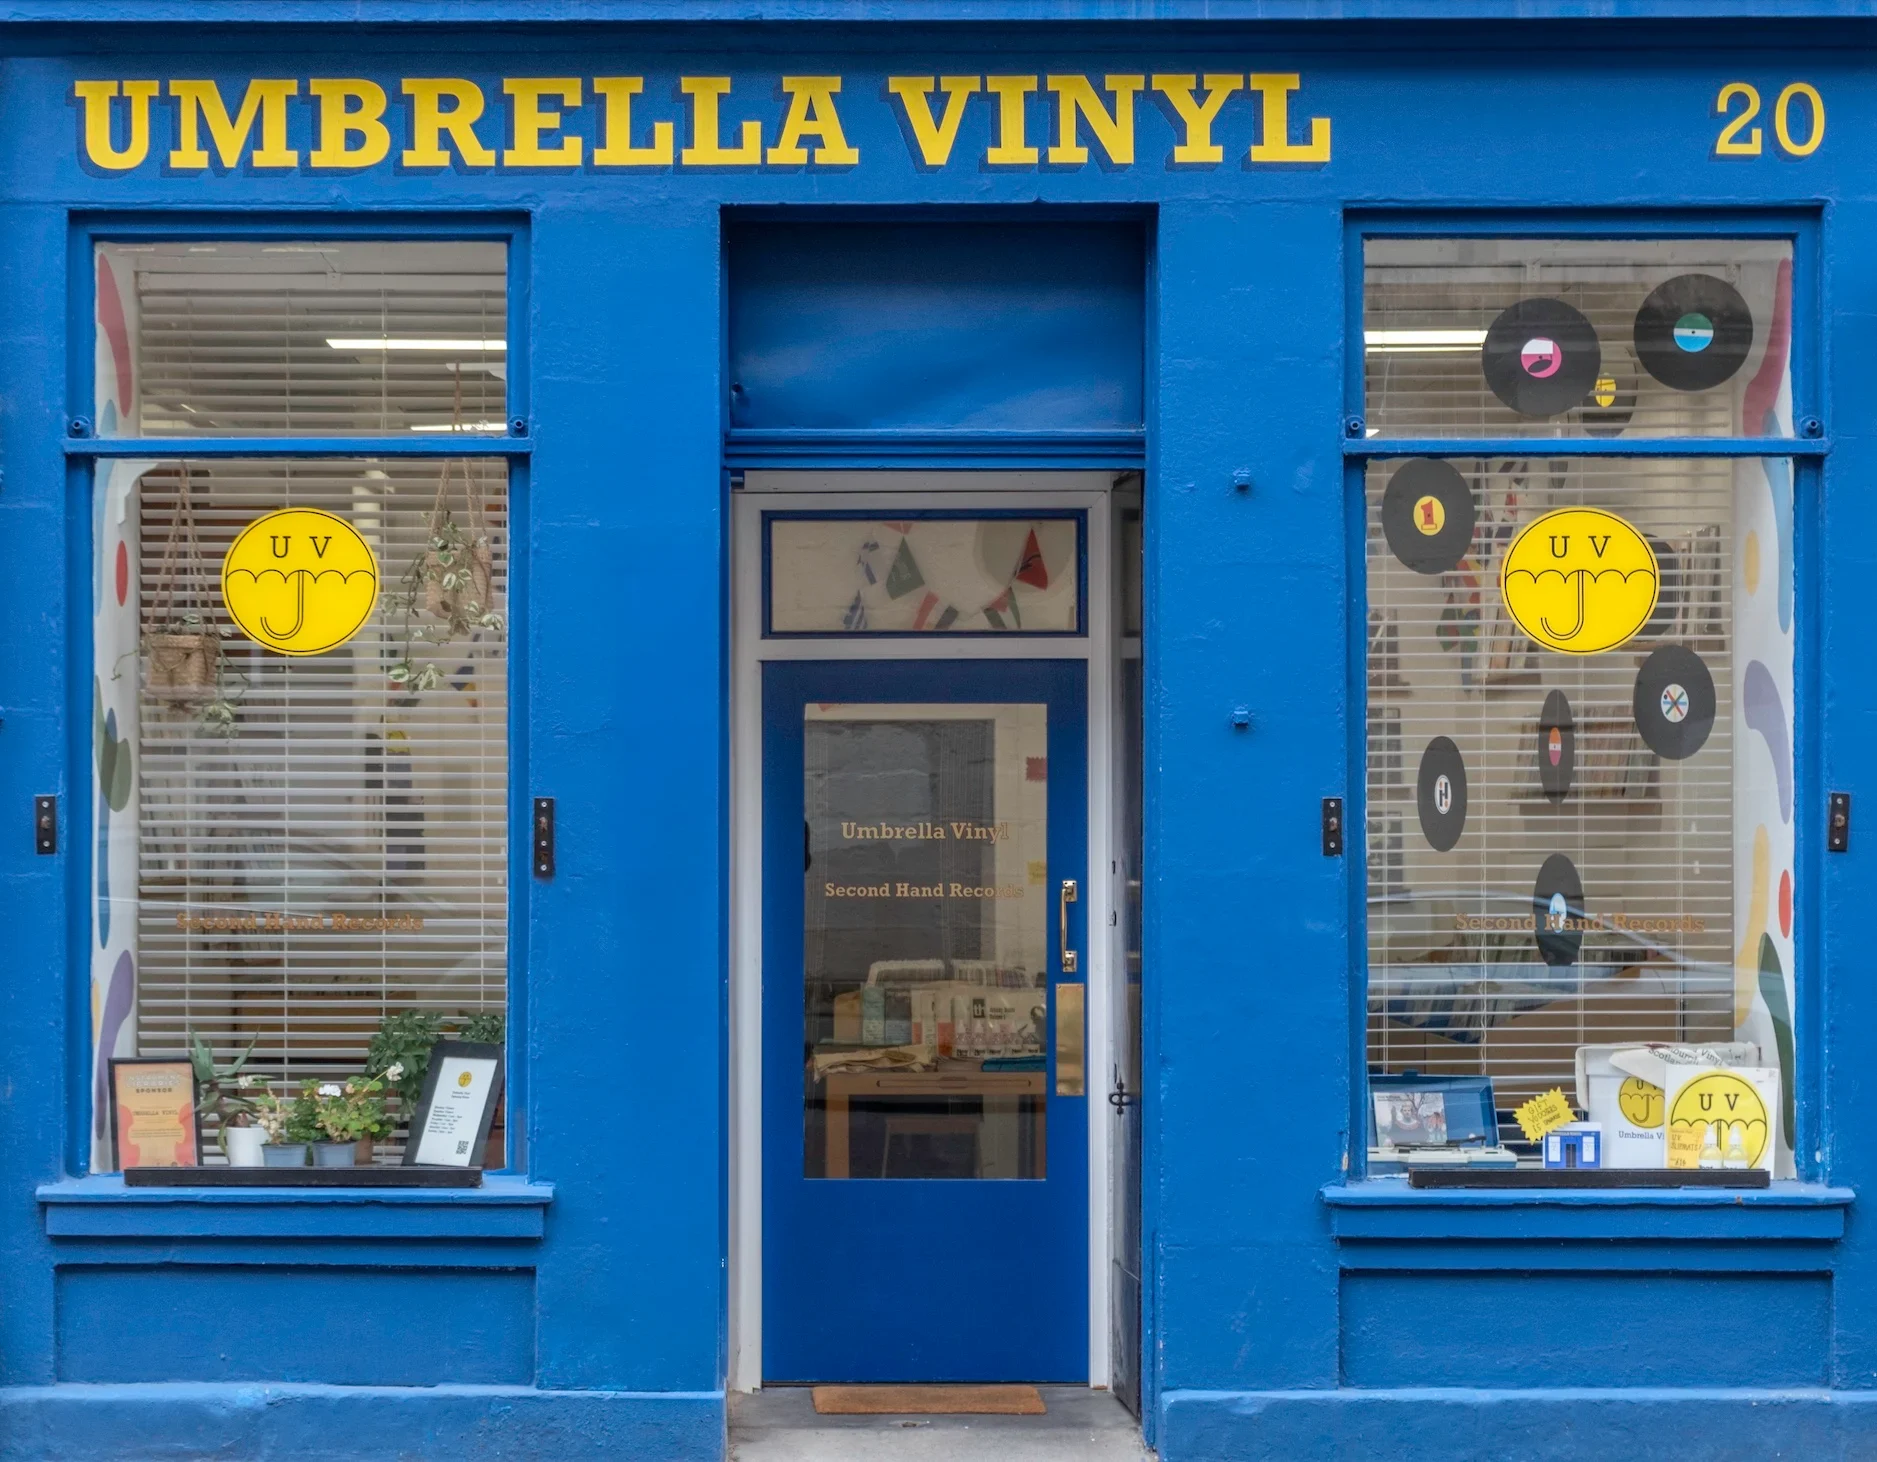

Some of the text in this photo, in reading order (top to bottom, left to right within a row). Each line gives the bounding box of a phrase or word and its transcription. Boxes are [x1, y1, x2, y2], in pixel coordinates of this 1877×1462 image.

[73, 73, 1331, 171] UMBRELLA VINYL
[1715, 82, 1825, 156] 20
[841, 822, 1009, 845] Umbrella Vinyl
[825, 883, 1024, 898] Second Hand Records
[176, 912, 424, 931] Second Hand Records
[1456, 912, 1705, 932] Second Hand Records
[1528, 1098, 1548, 1115] GIFT
[1618, 1131, 1654, 1140] Umbrella
